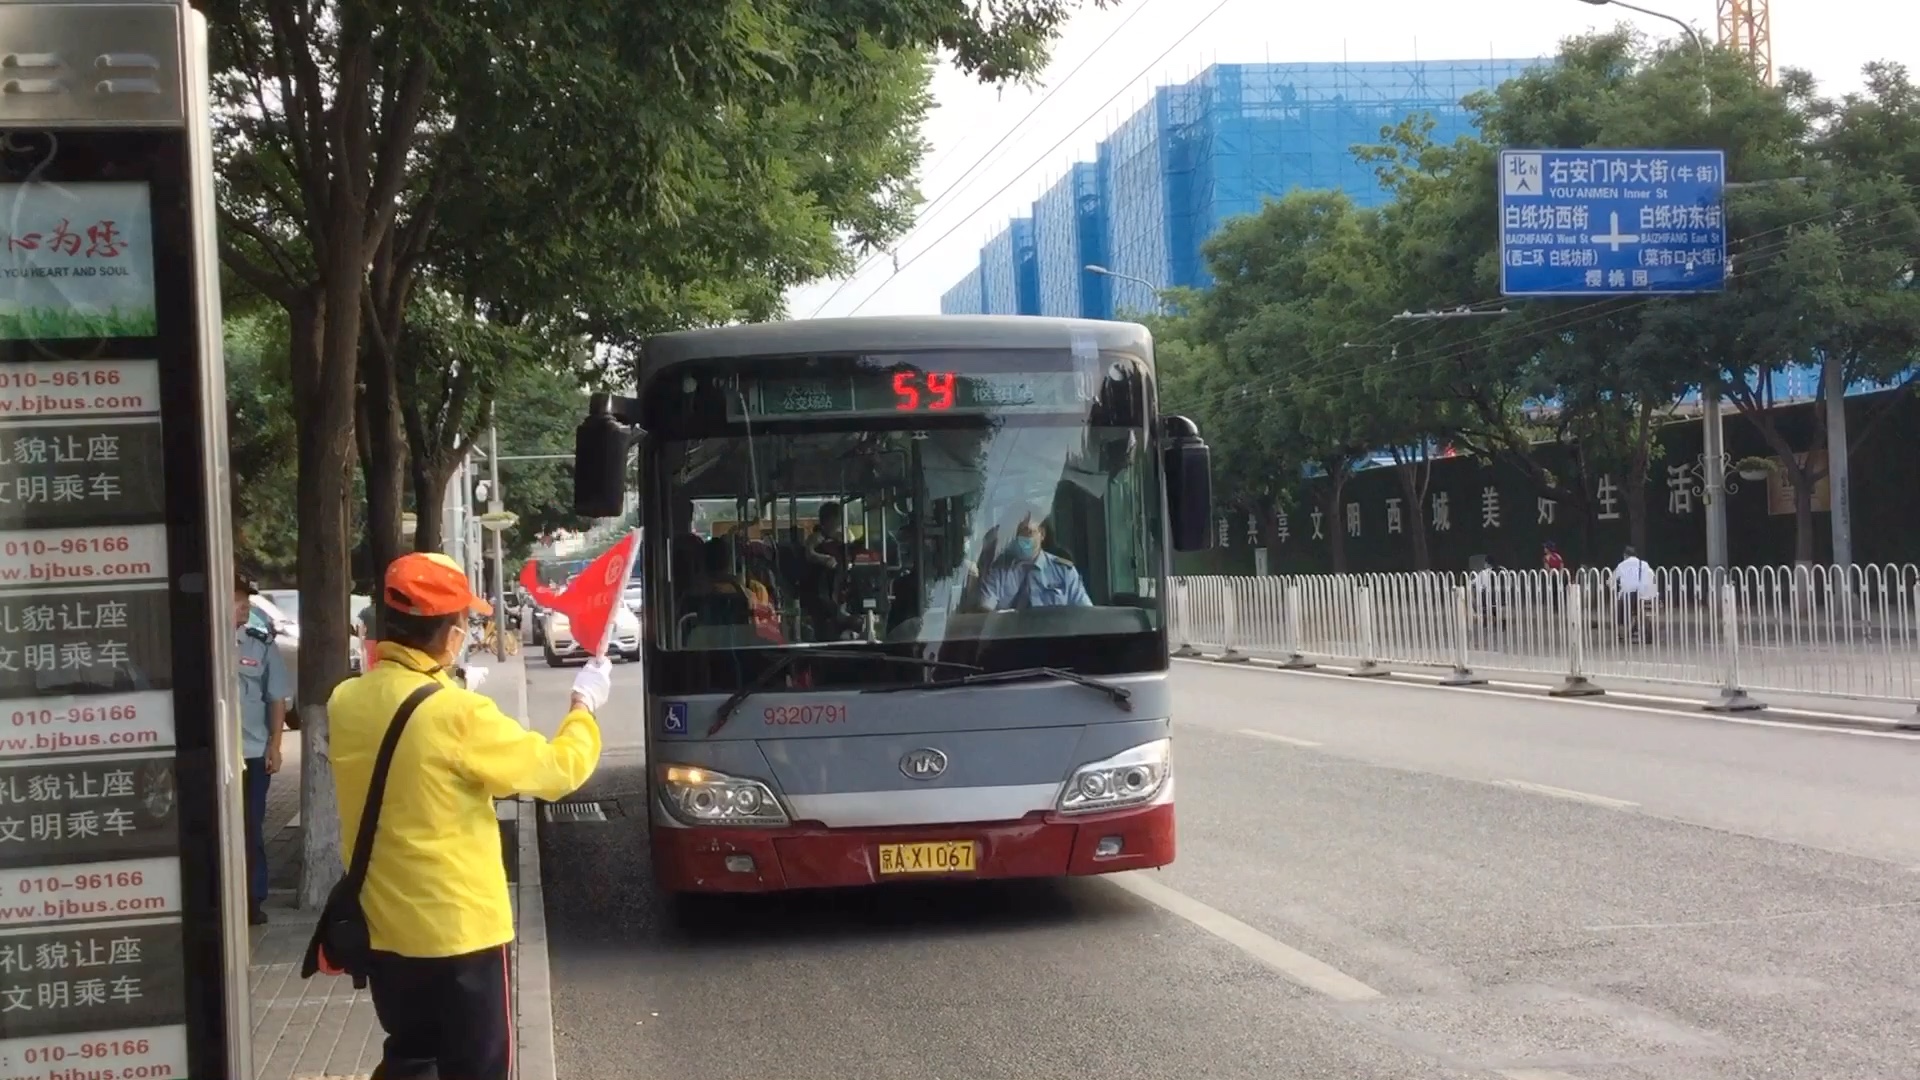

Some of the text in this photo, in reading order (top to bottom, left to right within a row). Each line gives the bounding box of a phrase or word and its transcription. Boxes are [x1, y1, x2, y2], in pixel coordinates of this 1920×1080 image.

[1510, 156, 1538, 175] 北 N
[1624, 188, 1651, 199] Inner
[1656, 187, 1668, 199] St
[1506, 205, 1589, 230] 白纸坊西街
[1639, 204, 1721, 229] 白纸坊东街
[1580, 233, 1589, 245] St
[1711, 232, 1720, 244] St
[31, 266, 69, 277] HEART
[72, 266, 97, 277] AND
[100, 265, 129, 276] SOUL
[893, 371, 954, 411] 59
[5, 537, 129, 556] 010-96166
[12, 705, 137, 726] 010-96166
[763, 704, 846, 725] 9320791
[0, 807, 137, 842] 文明乘车
[19, 871, 144, 894] 010-96166
[0, 936, 142, 974] 礼貌让座
[2, 975, 143, 1012] 文明乘车
[24, 1039, 150, 1063] 010-96166
